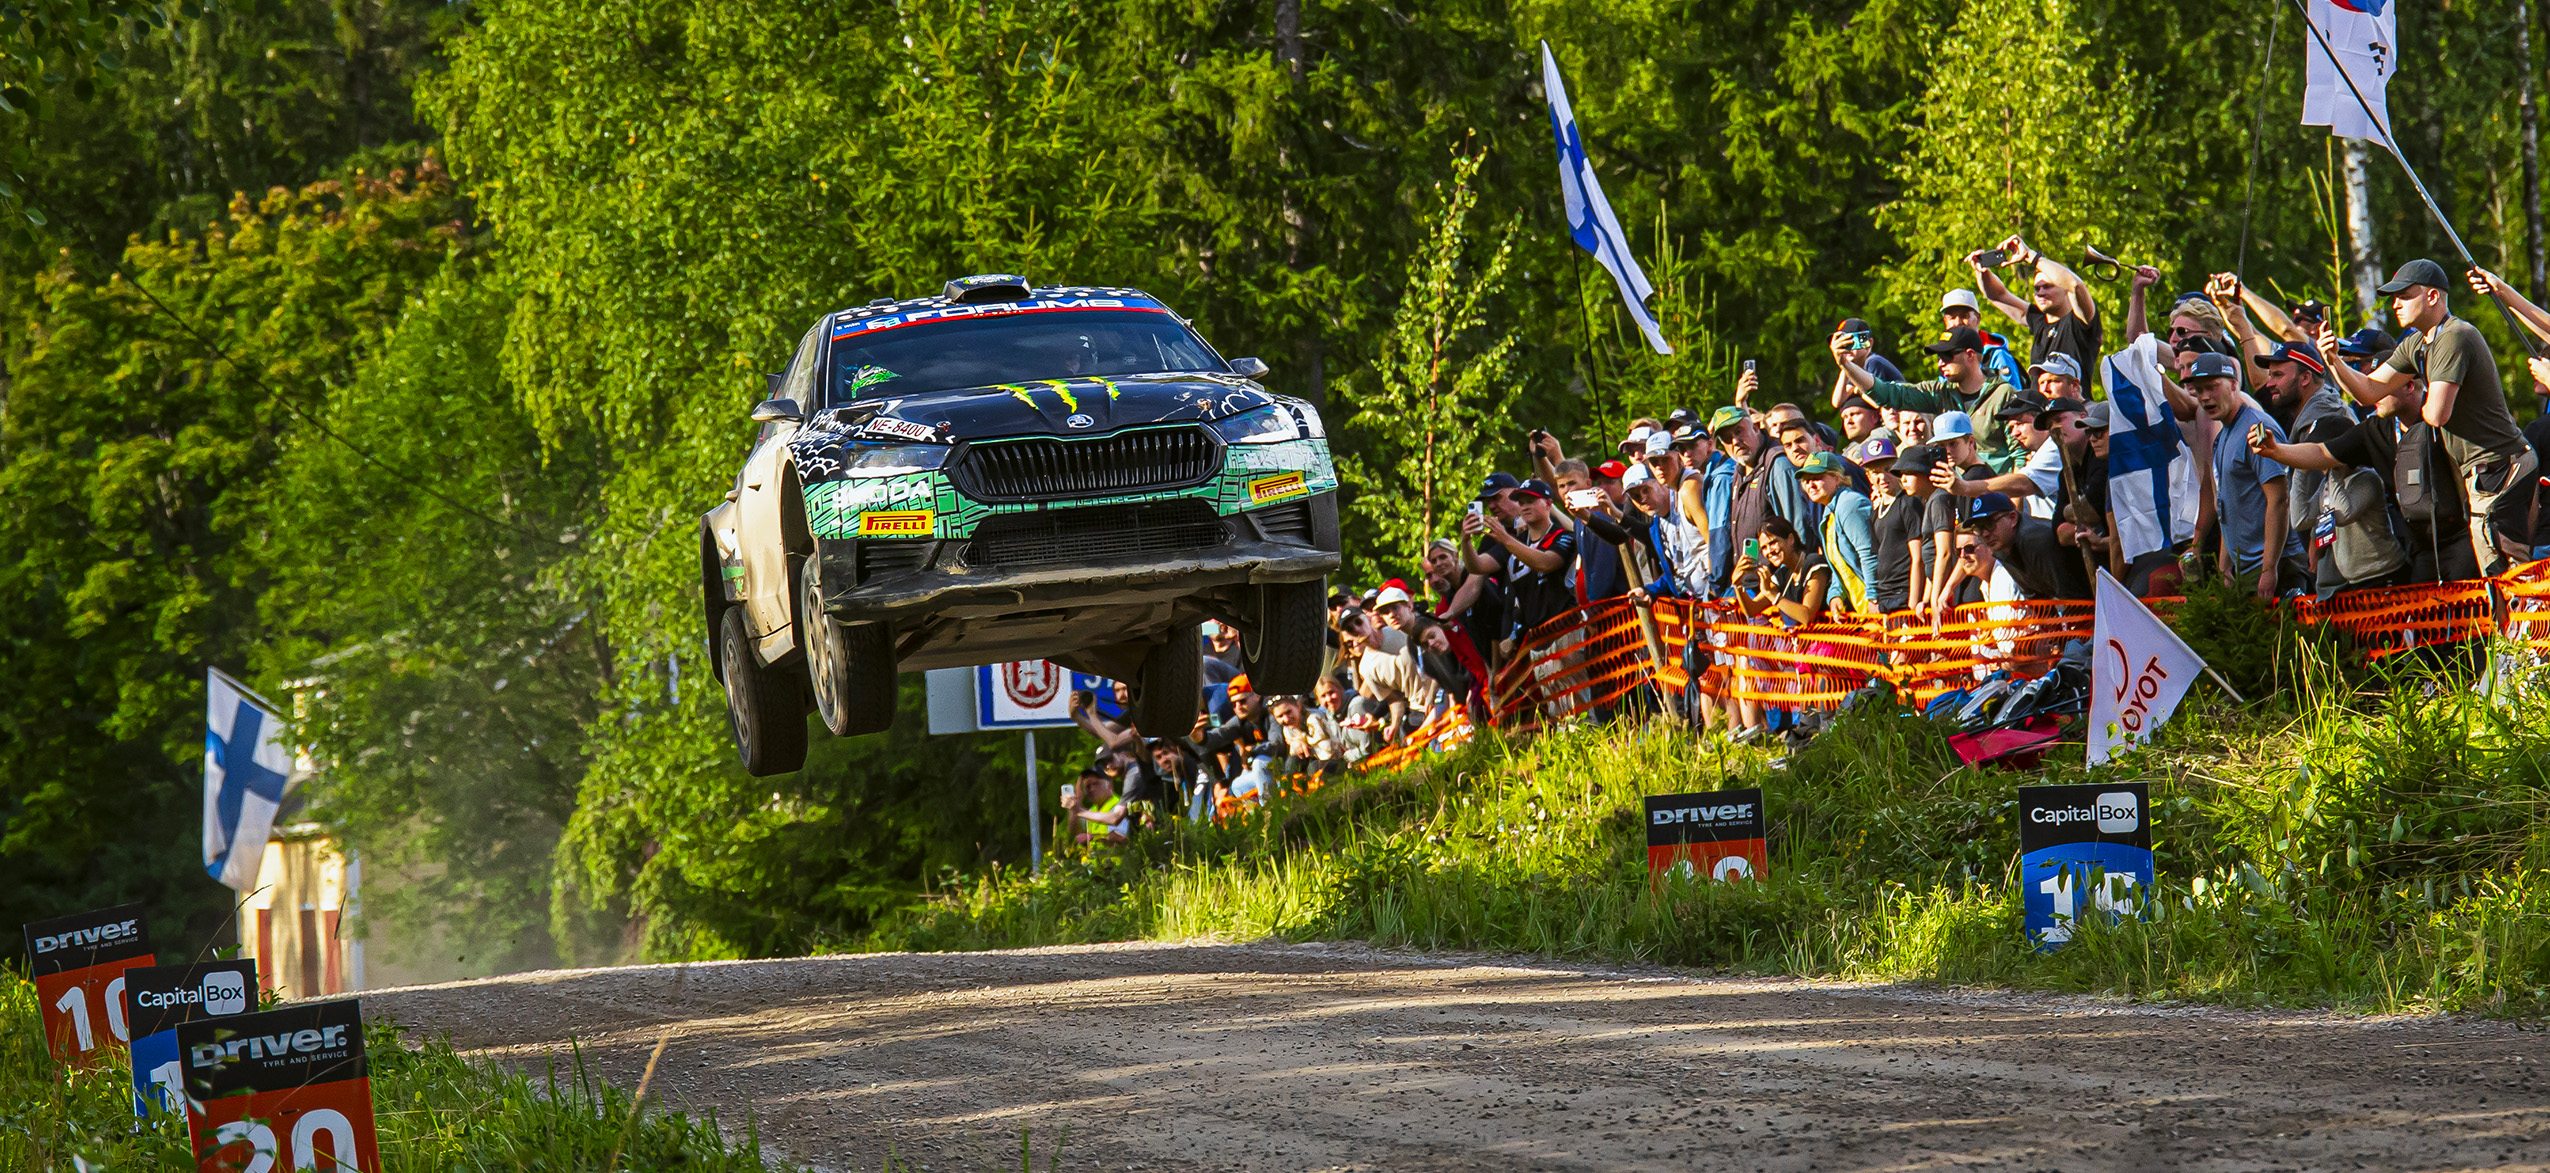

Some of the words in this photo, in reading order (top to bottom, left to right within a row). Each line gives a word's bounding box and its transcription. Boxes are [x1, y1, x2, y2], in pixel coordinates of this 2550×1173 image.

[867, 419, 927, 437] NE-8400
[1255, 476, 1301, 499] PIRELLI
[866, 515, 927, 531] PIRELLI
[83, 944, 98, 952] TYRE
[114, 936, 139, 946] SERVICE
[263, 1059, 285, 1068] TYRE
[289, 1056, 308, 1065] AND
[311, 1050, 348, 1062] SERVICE
